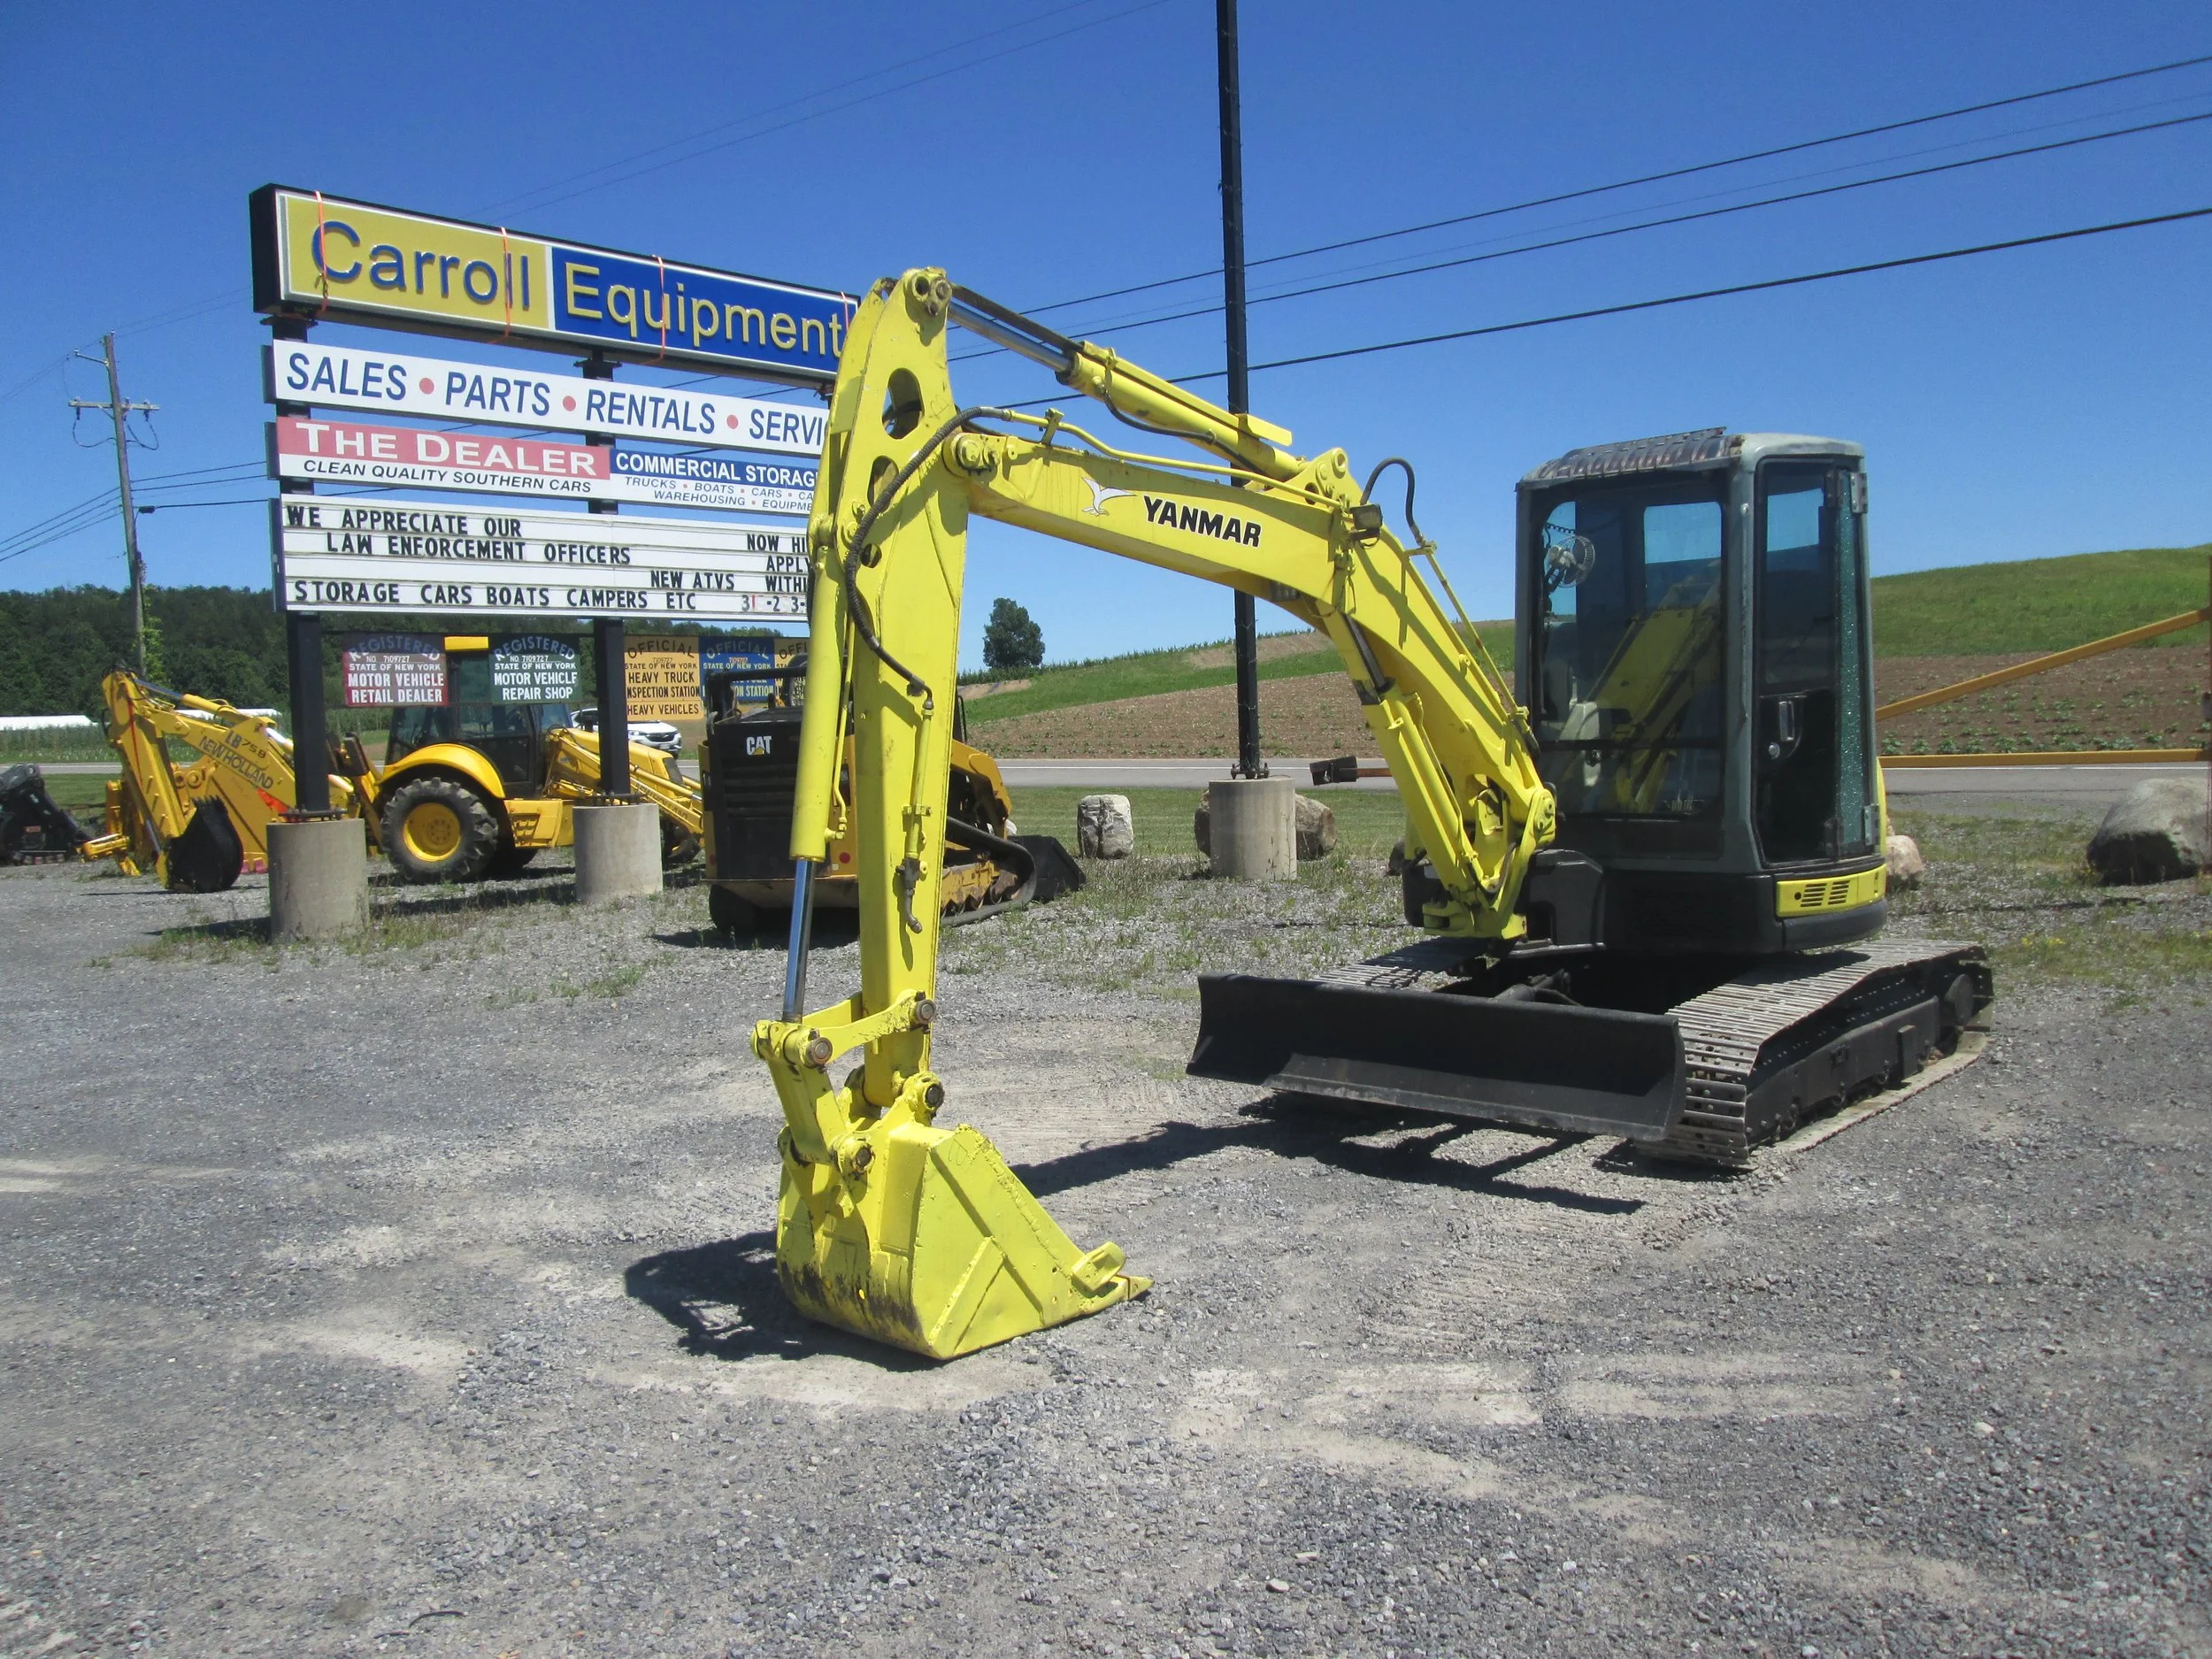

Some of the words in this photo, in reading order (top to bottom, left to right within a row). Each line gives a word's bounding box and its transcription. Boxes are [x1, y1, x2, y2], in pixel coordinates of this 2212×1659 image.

[311, 220, 530, 311] Carroll
[565, 262, 843, 357] Equipment
[287, 352, 407, 401] SALES
[445, 372, 550, 416] PARTS
[586, 388, 716, 434] RENTALS
[749, 409, 827, 445] SERVI
[296, 422, 398, 459] THE
[417, 434, 597, 476] DEALER
[303, 460, 365, 476] CLEAN
[372, 465, 449, 480] QUALITY
[452, 472, 545, 489] SOUTHERN
[549, 479, 592, 493] CARS
[616, 452, 741, 480] COMMERCIAL
[625, 476, 677, 489] TRUCKS
[695, 482, 734, 494] BOATS
[751, 488, 782, 498] CARS
[654, 490, 746, 506] WAREHOUSING
[763, 499, 812, 511] EQUIPME
[287, 505, 321, 527] WE
[342, 509, 468, 535] APPRECIATE
[484, 517, 521, 537] OUR
[1143, 495, 1262, 548] YANMAR
[326, 532, 373, 554] LAW
[388, 535, 526, 560] ENFORCEMENT
[544, 542, 631, 564] OFFICERS
[747, 534, 779, 551] NOW
[650, 570, 683, 588] NEW
[693, 572, 734, 590] ATVS
[765, 575, 806, 592] WITHI
[295, 580, 399, 603] STORAGE
[420, 585, 472, 605] CARS
[487, 586, 549, 606] BOATS
[566, 588, 648, 608] CAMPERS
[666, 592, 696, 610] ETC
[349, 635, 441, 662] REGISTERED
[494, 636, 575, 662] REGISTERED
[627, 640, 695, 658] OFFICIAL
[706, 640, 770, 659] OFFICIAL
[779, 641, 808, 659] OFFI
[348, 673, 390, 687] MOTOR
[396, 672, 444, 686] VEHICLE
[494, 672, 531, 685] MOTOR
[534, 672, 577, 684] VEHICLE
[628, 672, 658, 684] HEAVY
[664, 672, 695, 683] TRUCK
[351, 689, 394, 703] RETAIL
[397, 688, 442, 702] DEALER
[503, 687, 541, 700] REPAIR
[545, 687, 573, 699] SHOP
[626, 687, 669, 698] NSPECTION
[671, 686, 700, 697] STATION
[627, 705, 655, 715] HEAVY
[658, 703, 699, 714] VEHICLES
[746, 735, 772, 756] CAT
[223, 749, 274, 789] HOLLAND
